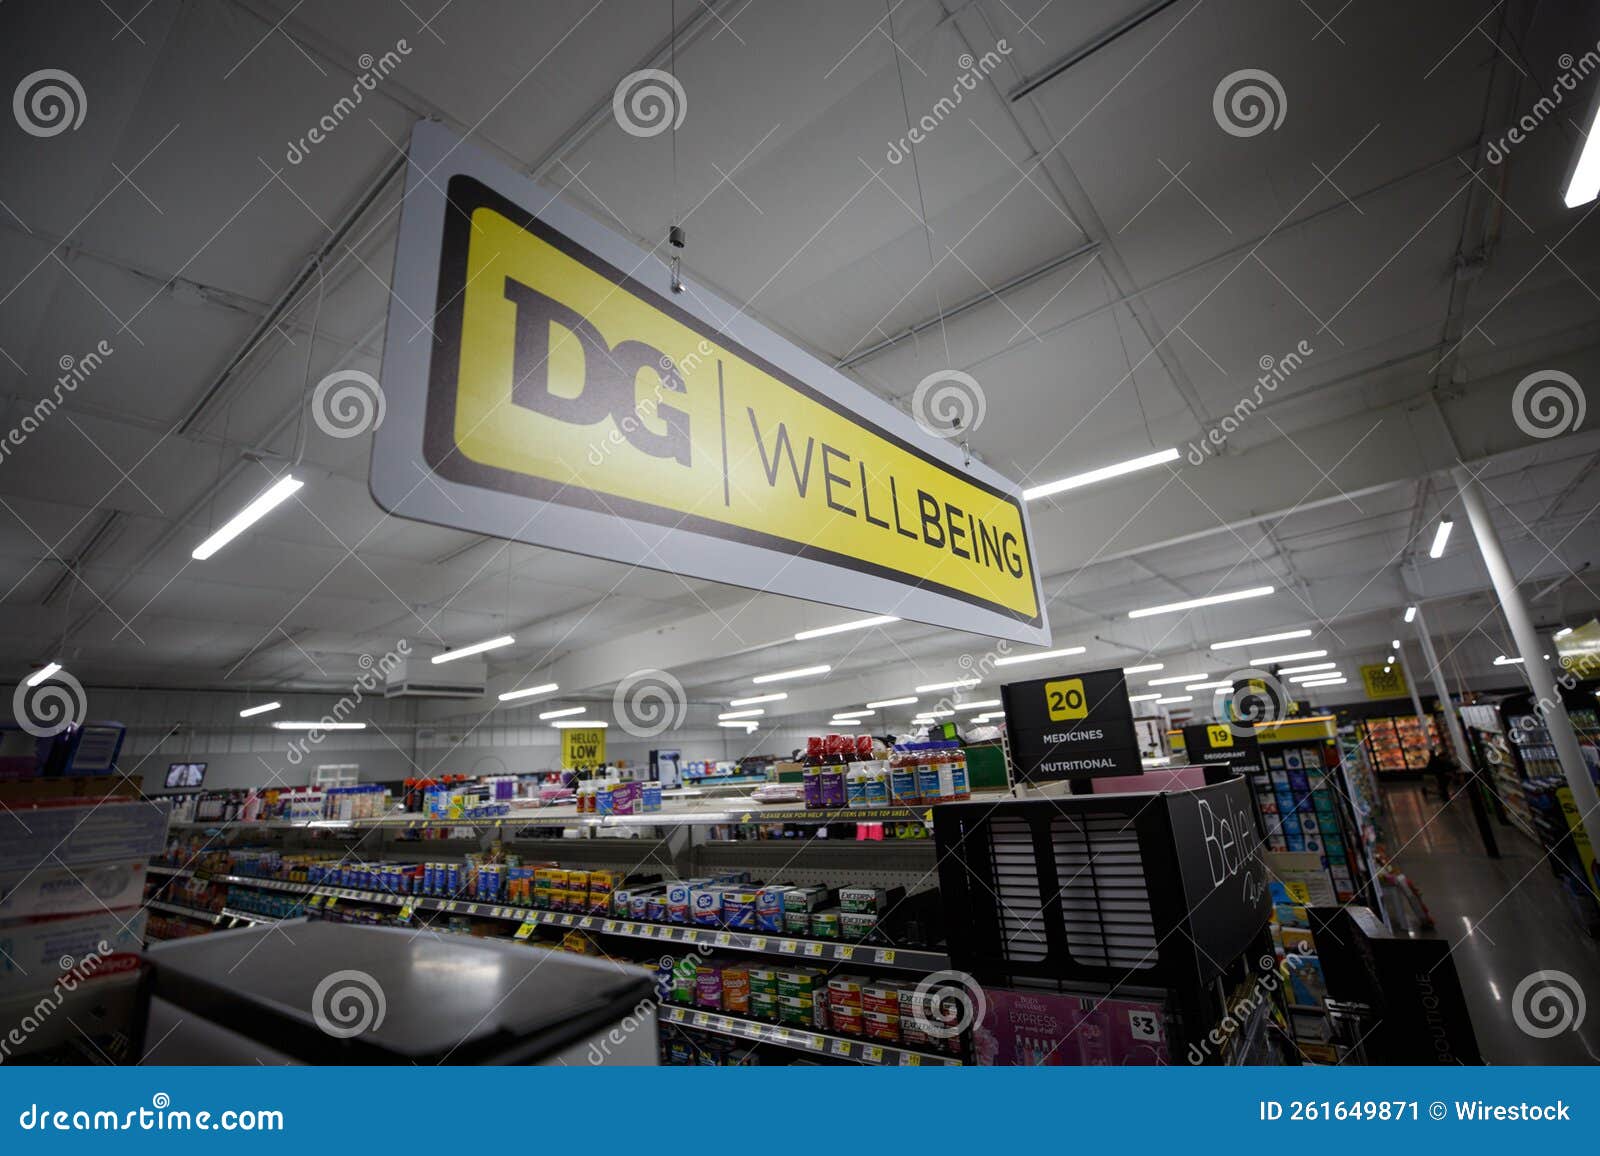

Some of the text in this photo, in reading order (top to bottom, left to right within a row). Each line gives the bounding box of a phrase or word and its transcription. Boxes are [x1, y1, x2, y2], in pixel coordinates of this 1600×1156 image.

[504, 275, 1023, 579] DG WELLBEING
[1050, 689, 1083, 712] 20
[1043, 729, 1104, 744] MEDICINES
[1211, 730, 1229, 742] 19
[570, 745, 597, 759] LOW
[1203, 751, 1246, 761] DEODORANT
[1040, 758, 1117, 773] NUTRITIONAL
[1009, 1011, 1058, 1028] EXPRESS
[1133, 1016, 1155, 1035] $3
[1416, 973, 1454, 1063] BOUTIQUE
